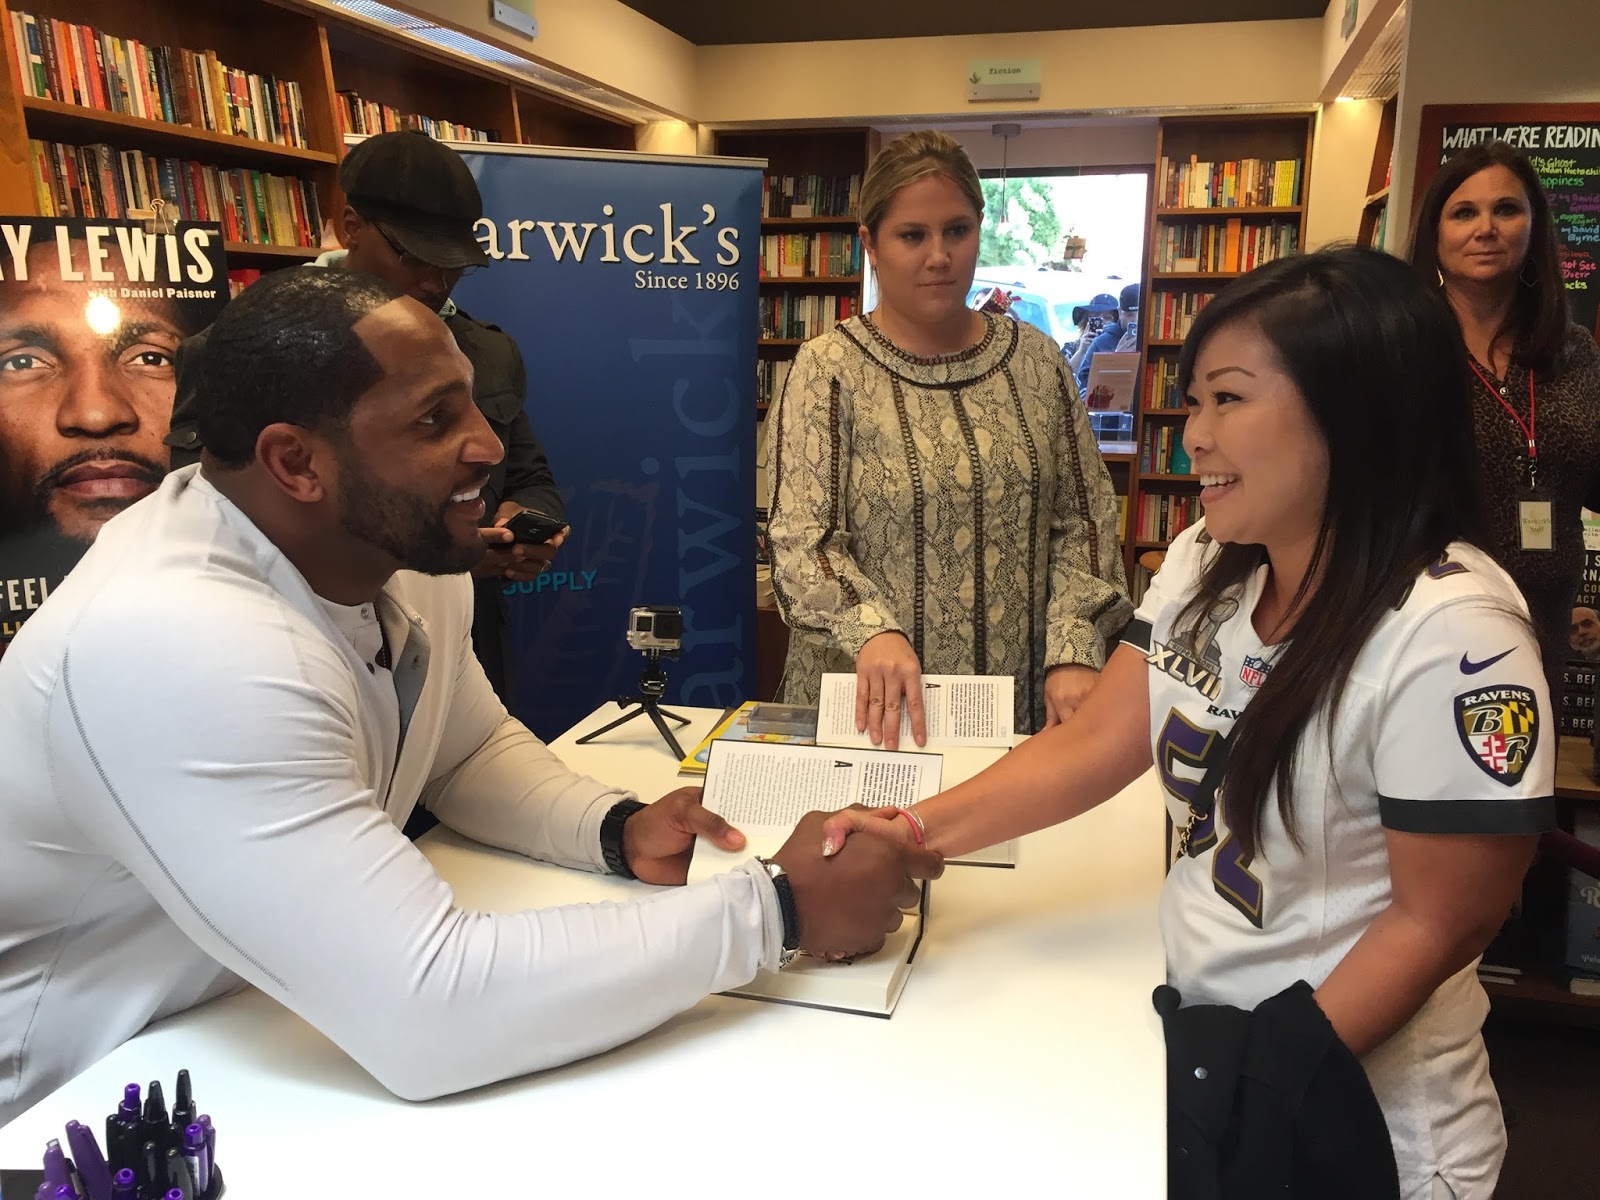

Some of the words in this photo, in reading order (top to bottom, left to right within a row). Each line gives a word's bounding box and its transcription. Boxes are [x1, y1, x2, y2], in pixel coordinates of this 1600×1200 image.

[988, 67, 1021, 75] fiction
[1442, 126, 1492, 149] WHAT
[1493, 125, 1541, 149] WE'RE
[1540, 166, 1562, 174] Adam
[1547, 157, 1577, 169] Ghost
[472, 202, 741, 267] arwick's
[1572, 225, 1600, 234] David
[1567, 233, 1600, 245] Byrne
[0, 224, 33, 282] Y
[55, 224, 215, 284] LEWIS
[1579, 260, 1596, 271] See
[634, 269, 689, 290] Since
[695, 271, 741, 292] 1896
[120, 287, 164, 299] Daniel
[166, 287, 217, 300] Paisner
[1143, 640, 1223, 702] XLVII
[1462, 689, 1532, 707] RAVENS
[1465, 705, 1506, 735] B
